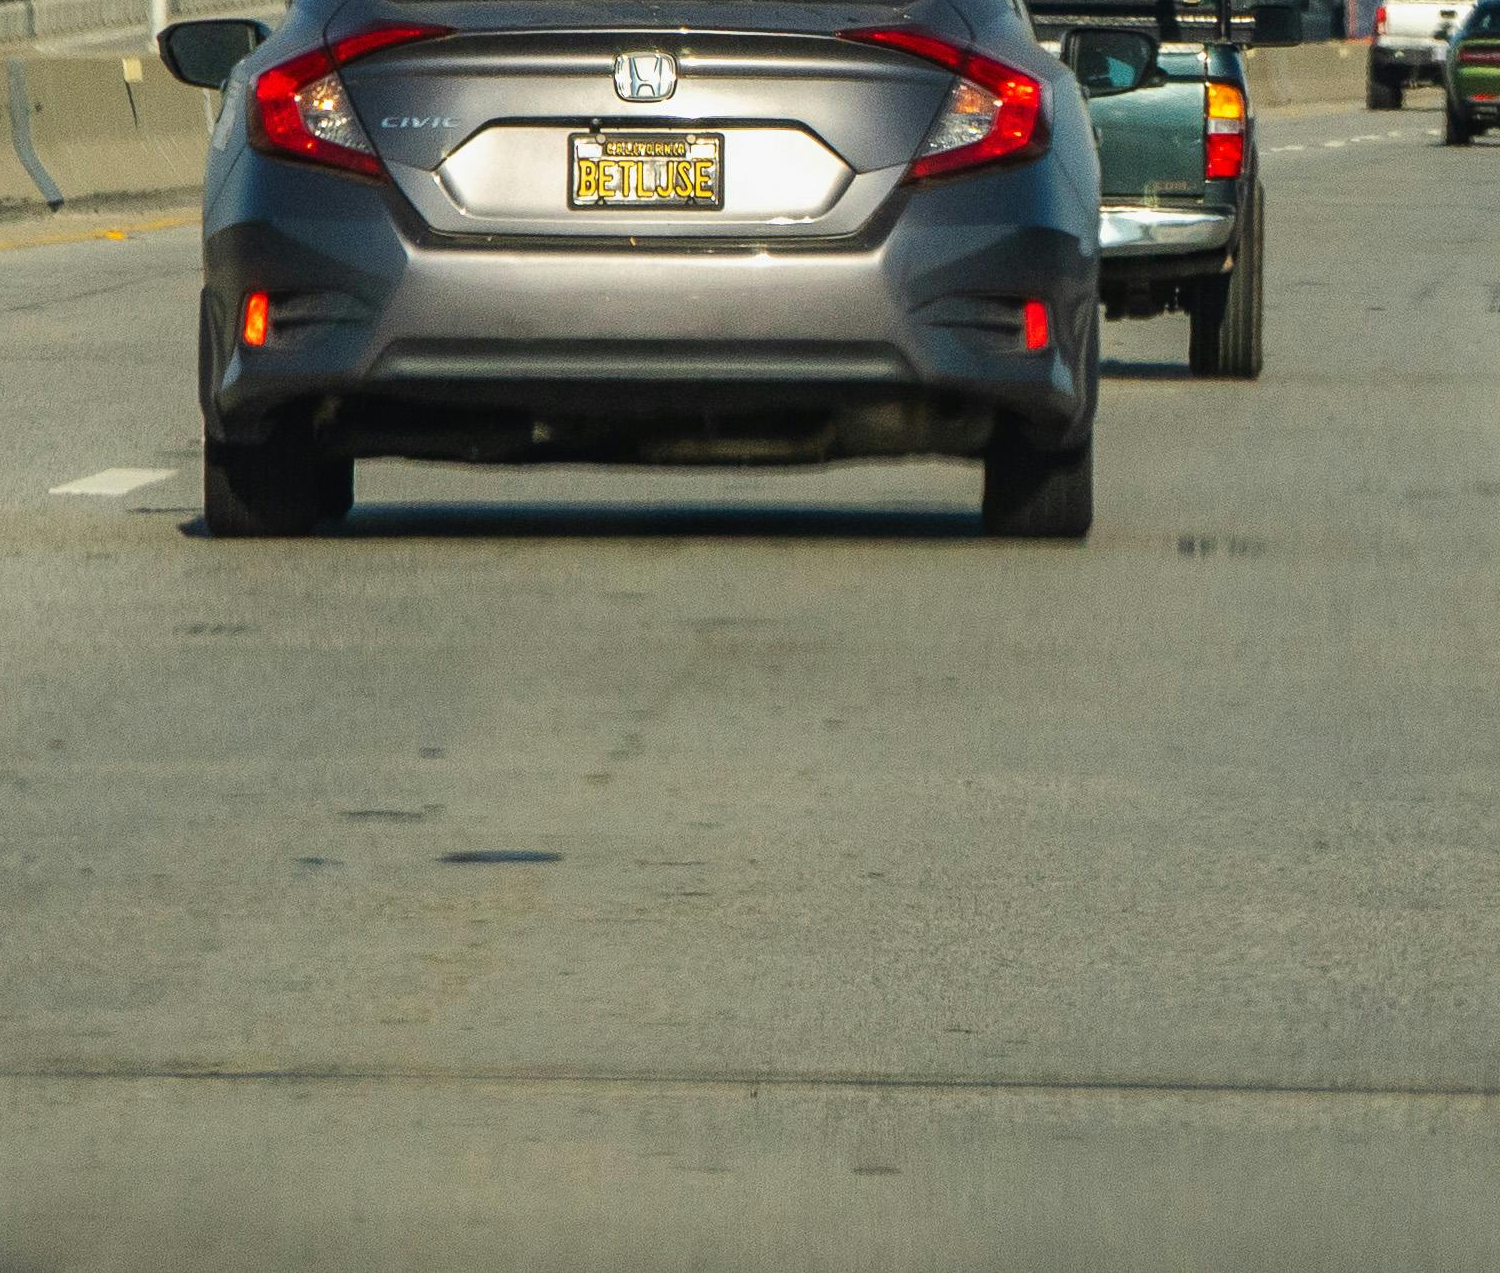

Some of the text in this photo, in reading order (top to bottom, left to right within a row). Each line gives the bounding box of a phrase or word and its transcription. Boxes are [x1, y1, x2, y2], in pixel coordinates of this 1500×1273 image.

[380, 116, 460, 129] CIVIC
[606, 141, 687, 157] CALIFORNIA
[577, 159, 715, 198] BETLJSE
